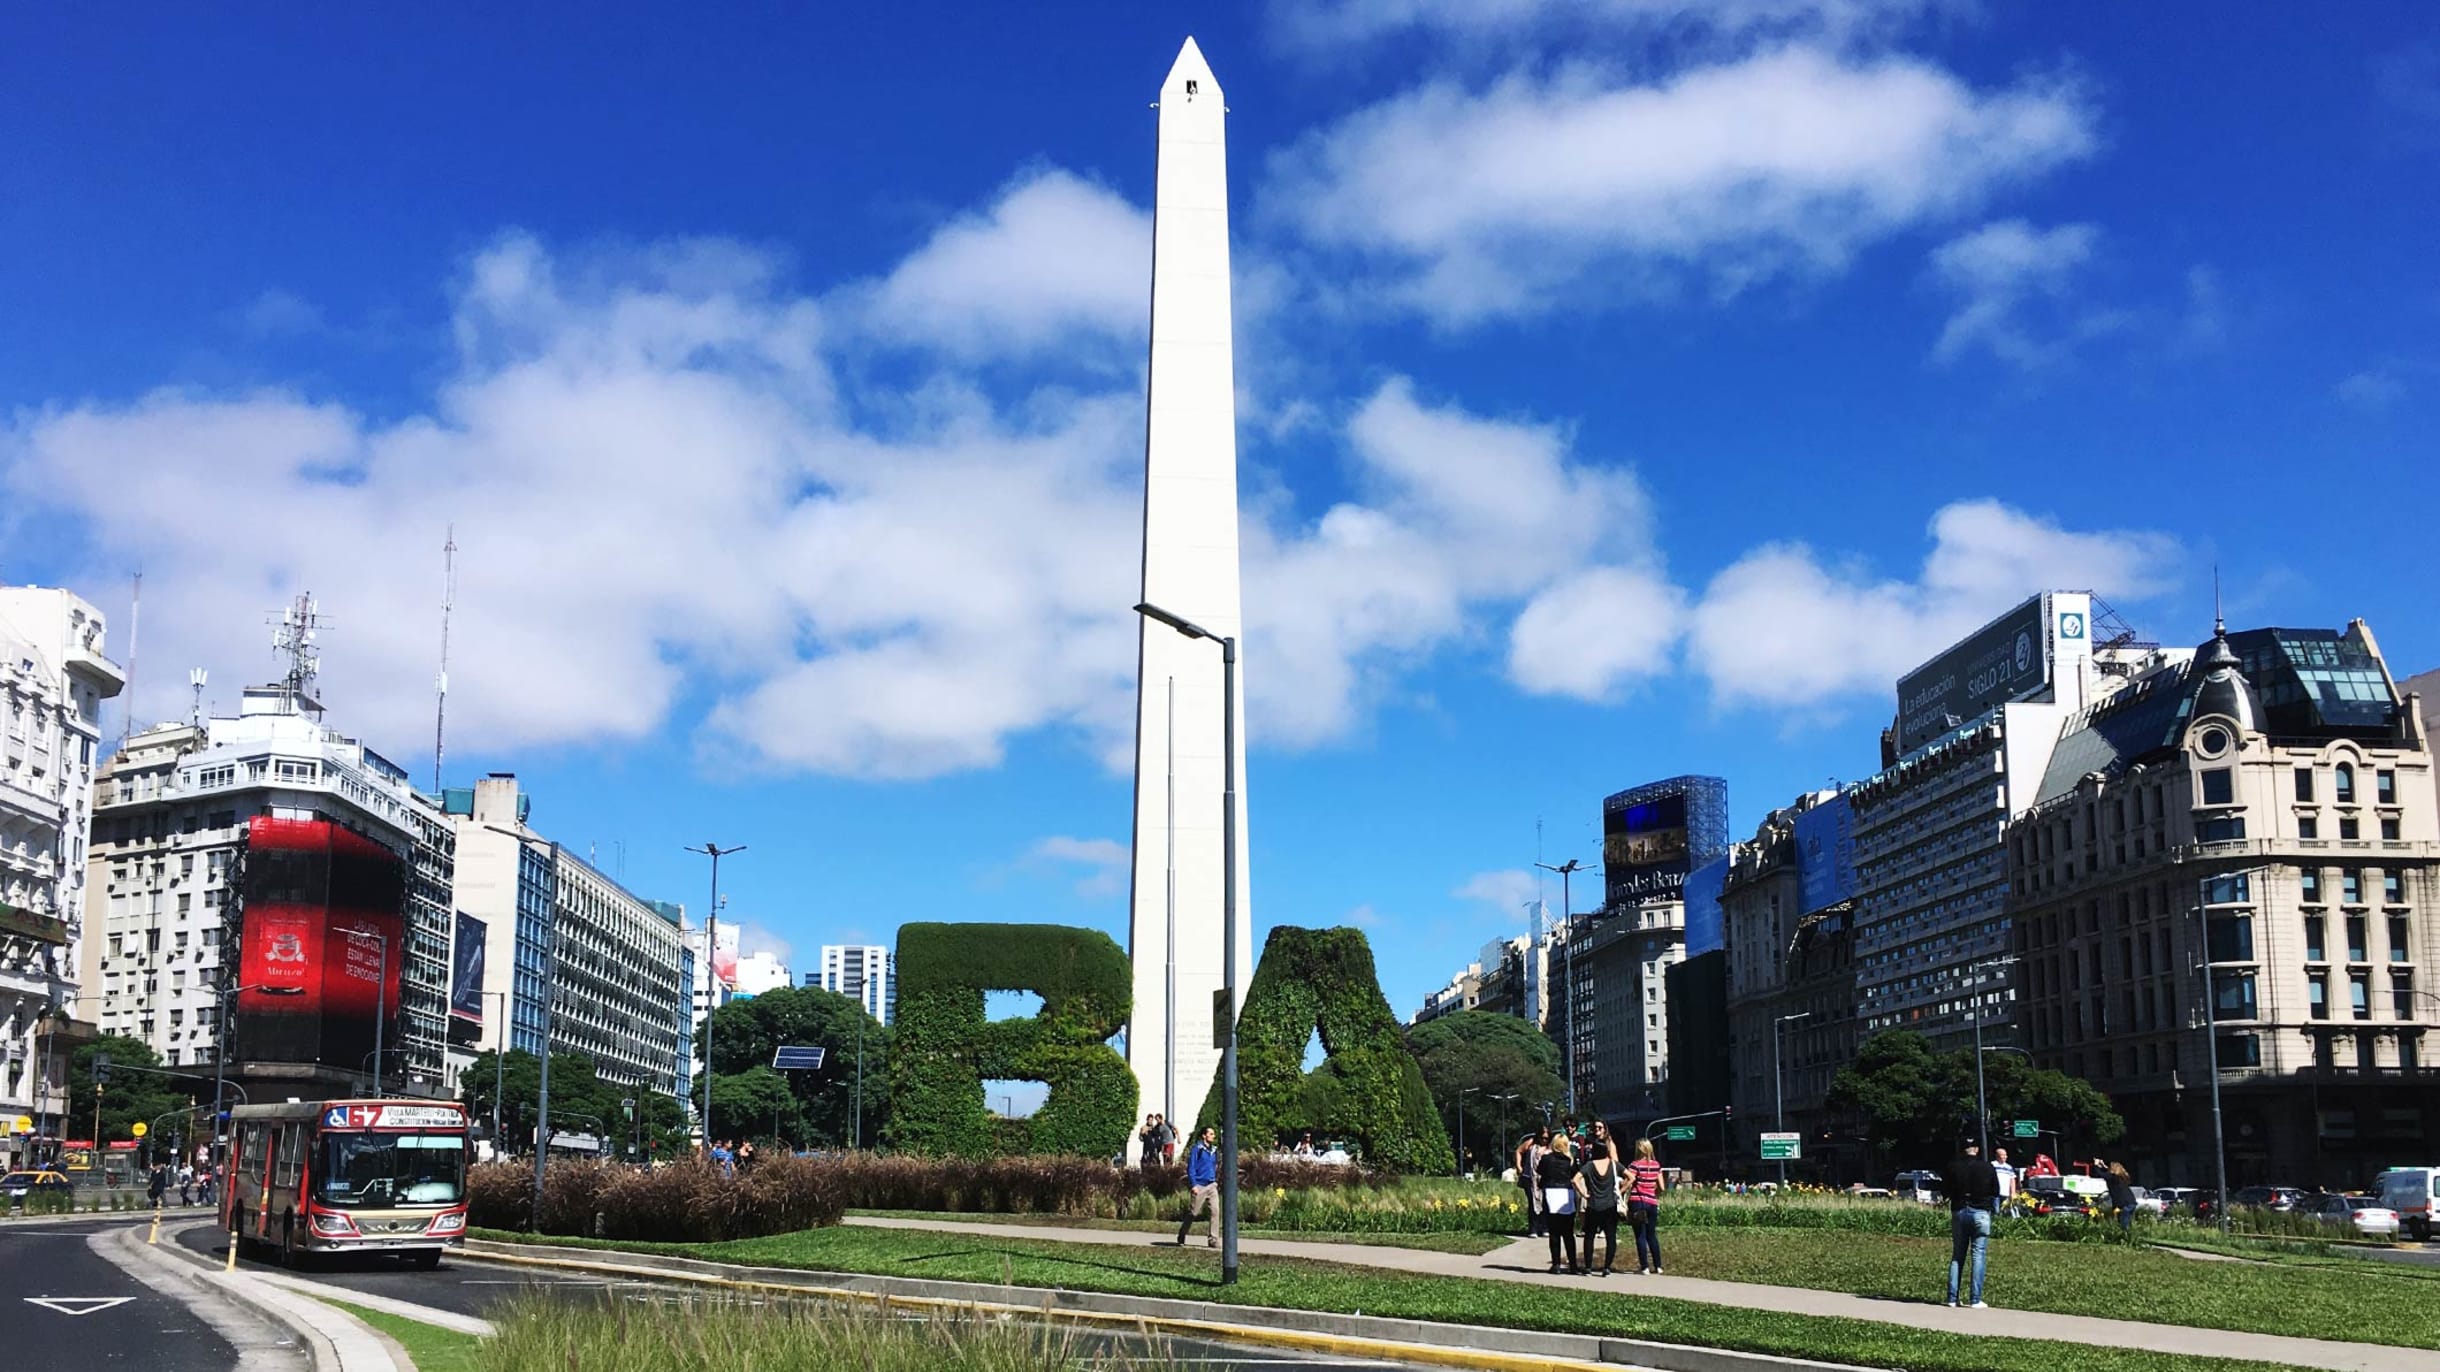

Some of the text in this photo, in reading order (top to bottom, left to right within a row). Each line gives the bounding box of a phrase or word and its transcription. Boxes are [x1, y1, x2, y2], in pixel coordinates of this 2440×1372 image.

[1904, 674, 1956, 715] La educación
[1967, 659, 2012, 699] SIGLO 21
[1905, 702, 1946, 735] evoluciona
[354, 966, 381, 984] EMOCIONE
[348, 1106, 384, 1127] 67
